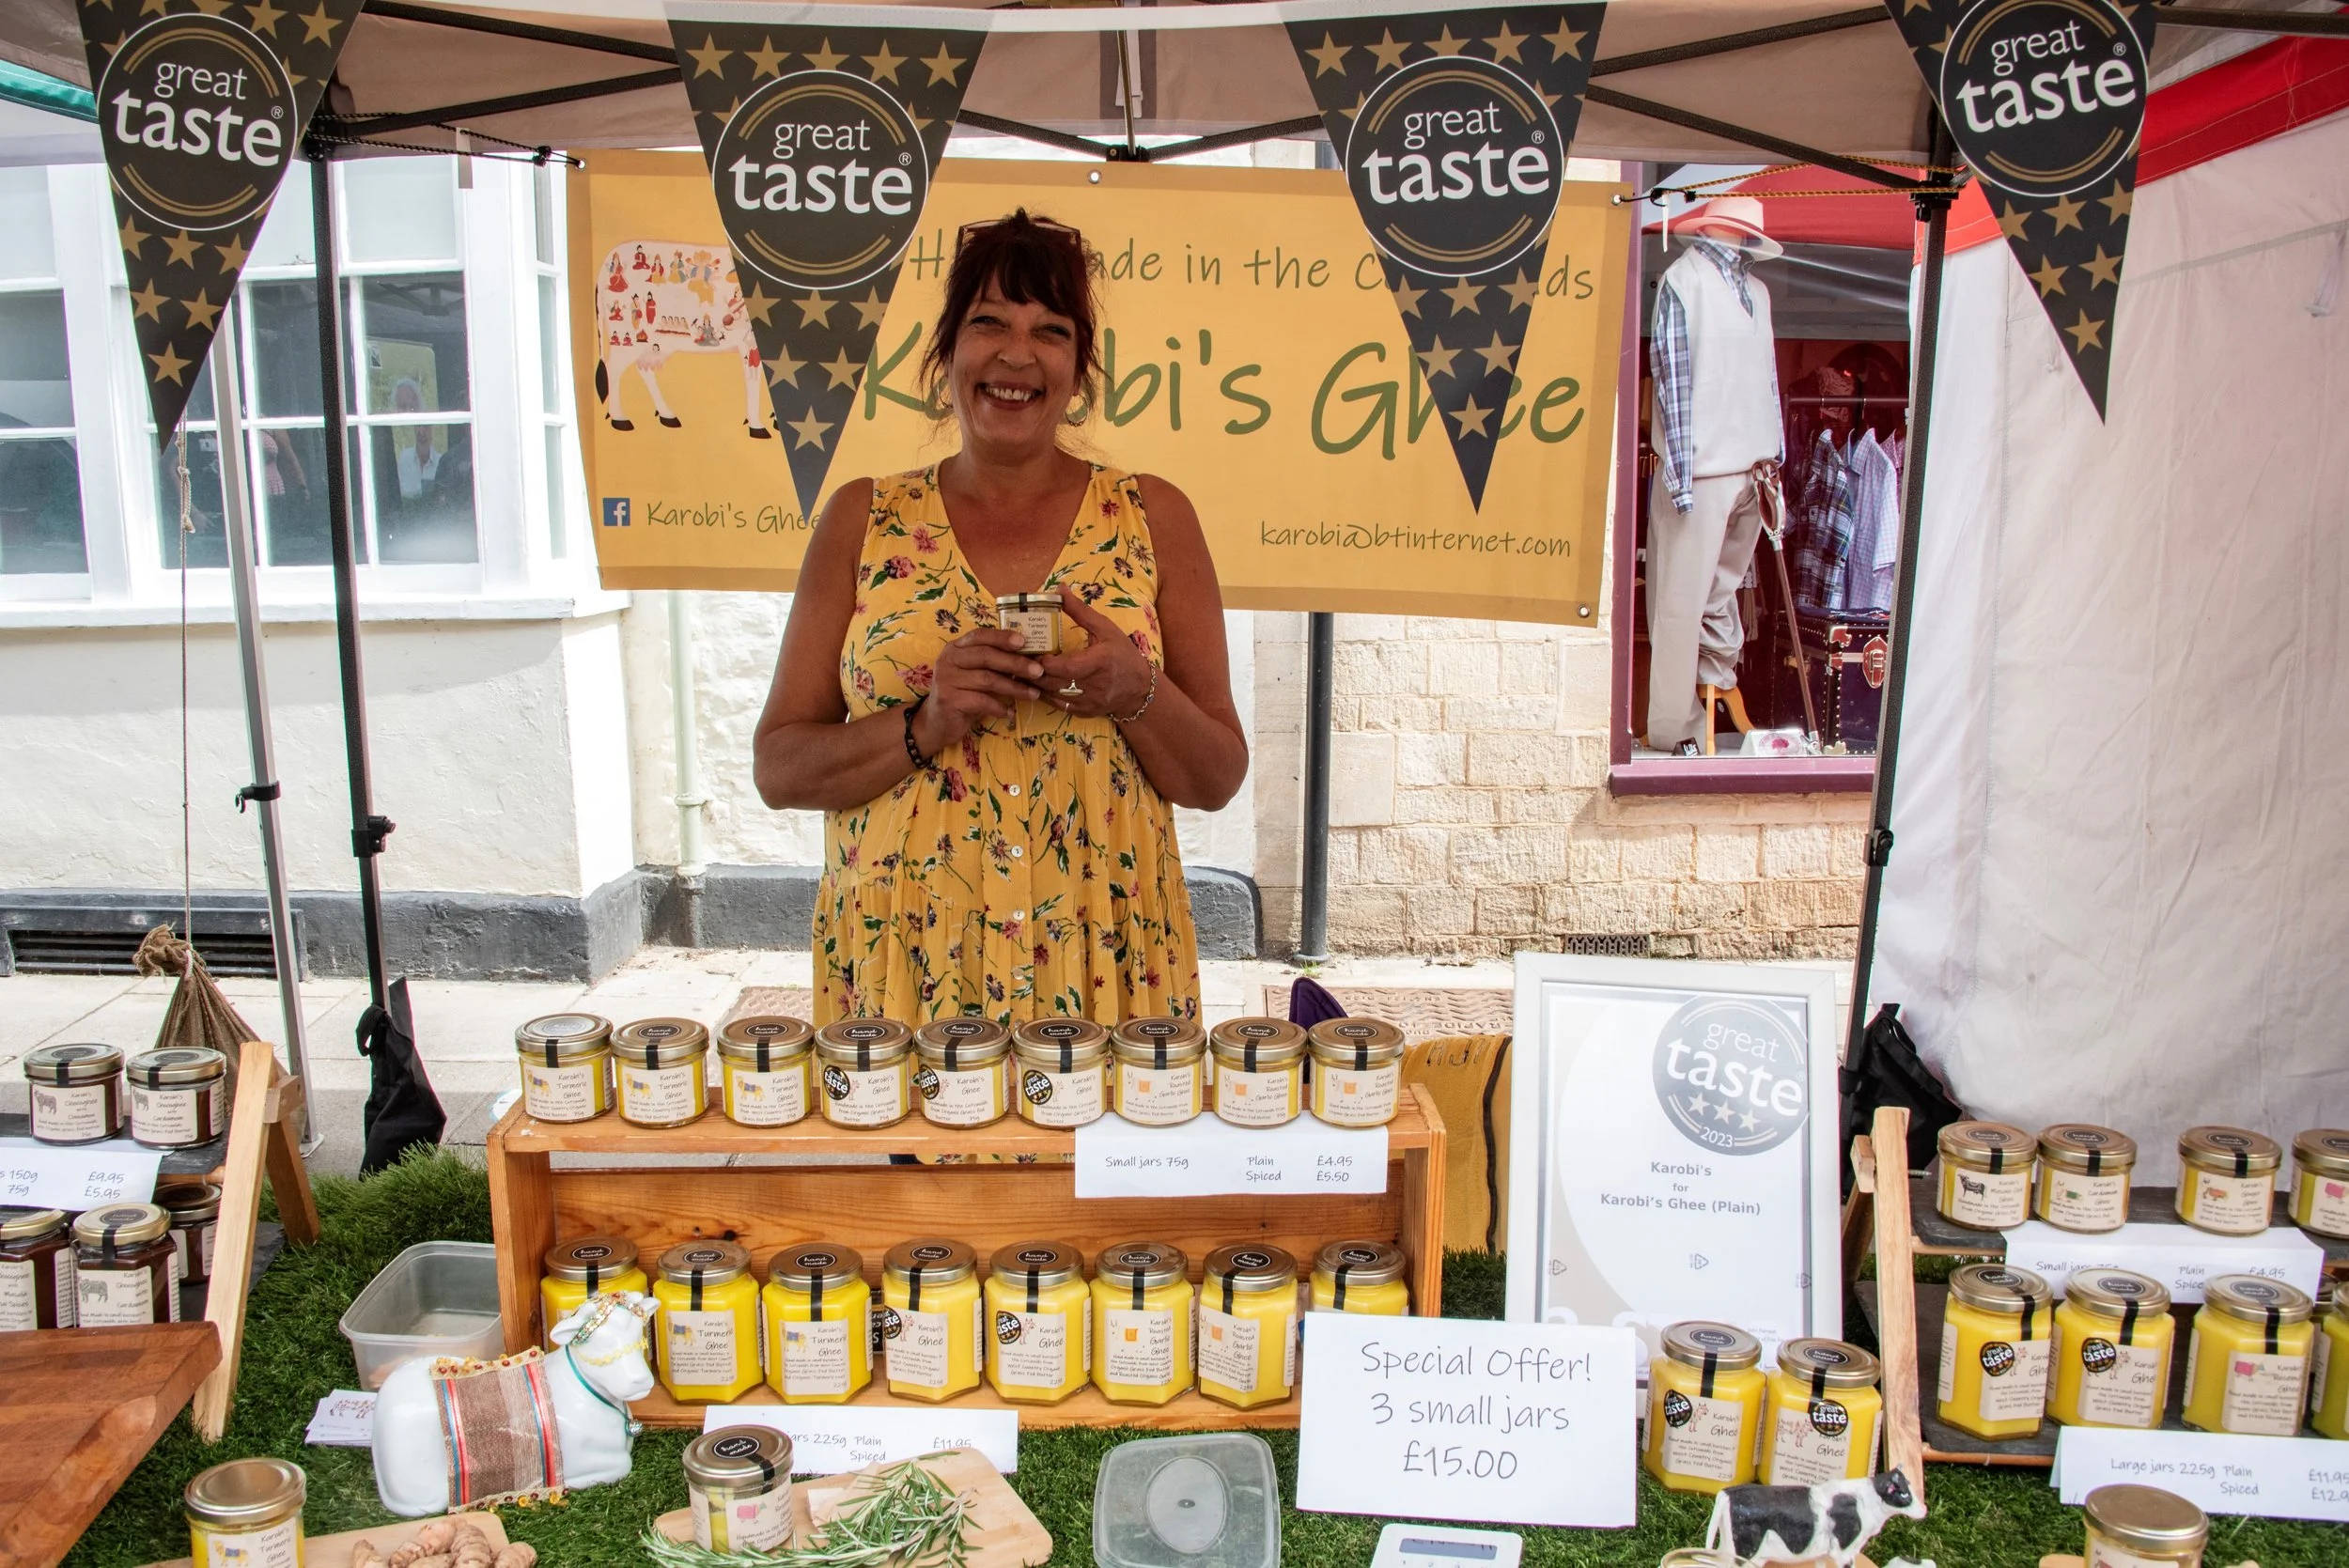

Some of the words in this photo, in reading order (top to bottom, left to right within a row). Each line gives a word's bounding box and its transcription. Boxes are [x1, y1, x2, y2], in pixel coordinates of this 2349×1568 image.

[1991, 20, 2085, 76] great
[154, 62, 247, 98] great
[1955, 59, 2136, 132] taste
[112, 88, 282, 166] taste
[1404, 101, 1501, 149] great
[772, 119, 870, 160] great
[1361, 141, 1549, 204] taste
[728, 154, 912, 215] taste
[1186, 244, 1220, 284] in
[1244, 246, 1330, 288] the
[646, 502, 747, 529] Karobi's
[1261, 521, 1571, 557] karobi@btinternet.com
[1703, 1022, 1779, 1062] great
[825, 1072, 848, 1094] taste
[1666, 1037, 1802, 1117] taste
[1025, 1078, 1050, 1096] taste
[1700, 1126, 1734, 1148] 2023
[1105, 1157, 1136, 1168] Small
[1139, 1157, 1162, 1171] jars
[1166, 1157, 1189, 1169] 75g
[1247, 1156, 1274, 1167] Plain
[1316, 1156, 1353, 1168] £4.95
[1651, 1161, 1712, 1177] Karobi's
[9, 1170, 39, 1183] 150g
[87, 1172, 124, 1183] £9.95
[1246, 1171, 1282, 1183] Spiced
[1316, 1171, 1349, 1183] £5.50
[8, 1185, 29, 1197] 75g
[85, 1186, 120, 1199] £5.95
[1672, 1183, 1689, 1193] for
[1668, 1197, 1706, 1212] Ghee
[1712, 1200, 1762, 1216] (Plain)
[2036, 1262, 2066, 1272] Small
[2180, 1266, 2205, 1275] Plain
[2249, 1267, 2285, 1278] £4.95
[2175, 1280, 2204, 1291] Spice
[706, 1341, 728, 1350] Ghee
[918, 1335, 943, 1346] Ghee
[1038, 1338, 1064, 1348] Ghee
[818, 1347, 842, 1357] Ghee
[1983, 1348, 2014, 1368] taste
[1986, 1346, 2003, 1358] great
[2083, 1347, 2116, 1363] taste
[1362, 1342, 1472, 1379] Special
[1487, 1347, 1592, 1383] Offer!
[1371, 1393, 1394, 1424] 3
[1409, 1395, 1491, 1425] small
[1501, 1395, 1570, 1434] jars
[1666, 1400, 1690, 1416] taste
[1820, 1405, 1839, 1414] great
[1812, 1412, 1847, 1424] taste
[721, 1439, 746, 1452] hand
[790, 1432, 809, 1442] ars
[814, 1434, 847, 1448] 225g
[854, 1436, 881, 1446] Plain
[729, 1444, 753, 1455] made
[850, 1451, 886, 1462] Spiced
[1816, 1444, 1845, 1456] Ghee
[1403, 1440, 1518, 1480] £15.00
[2110, 1458, 2147, 1474] Large
[2150, 1459, 2175, 1474] jars
[2180, 1463, 2216, 1479] 225g
[2224, 1465, 2253, 1478] Plain
[2220, 1482, 2260, 1496] Spiced
